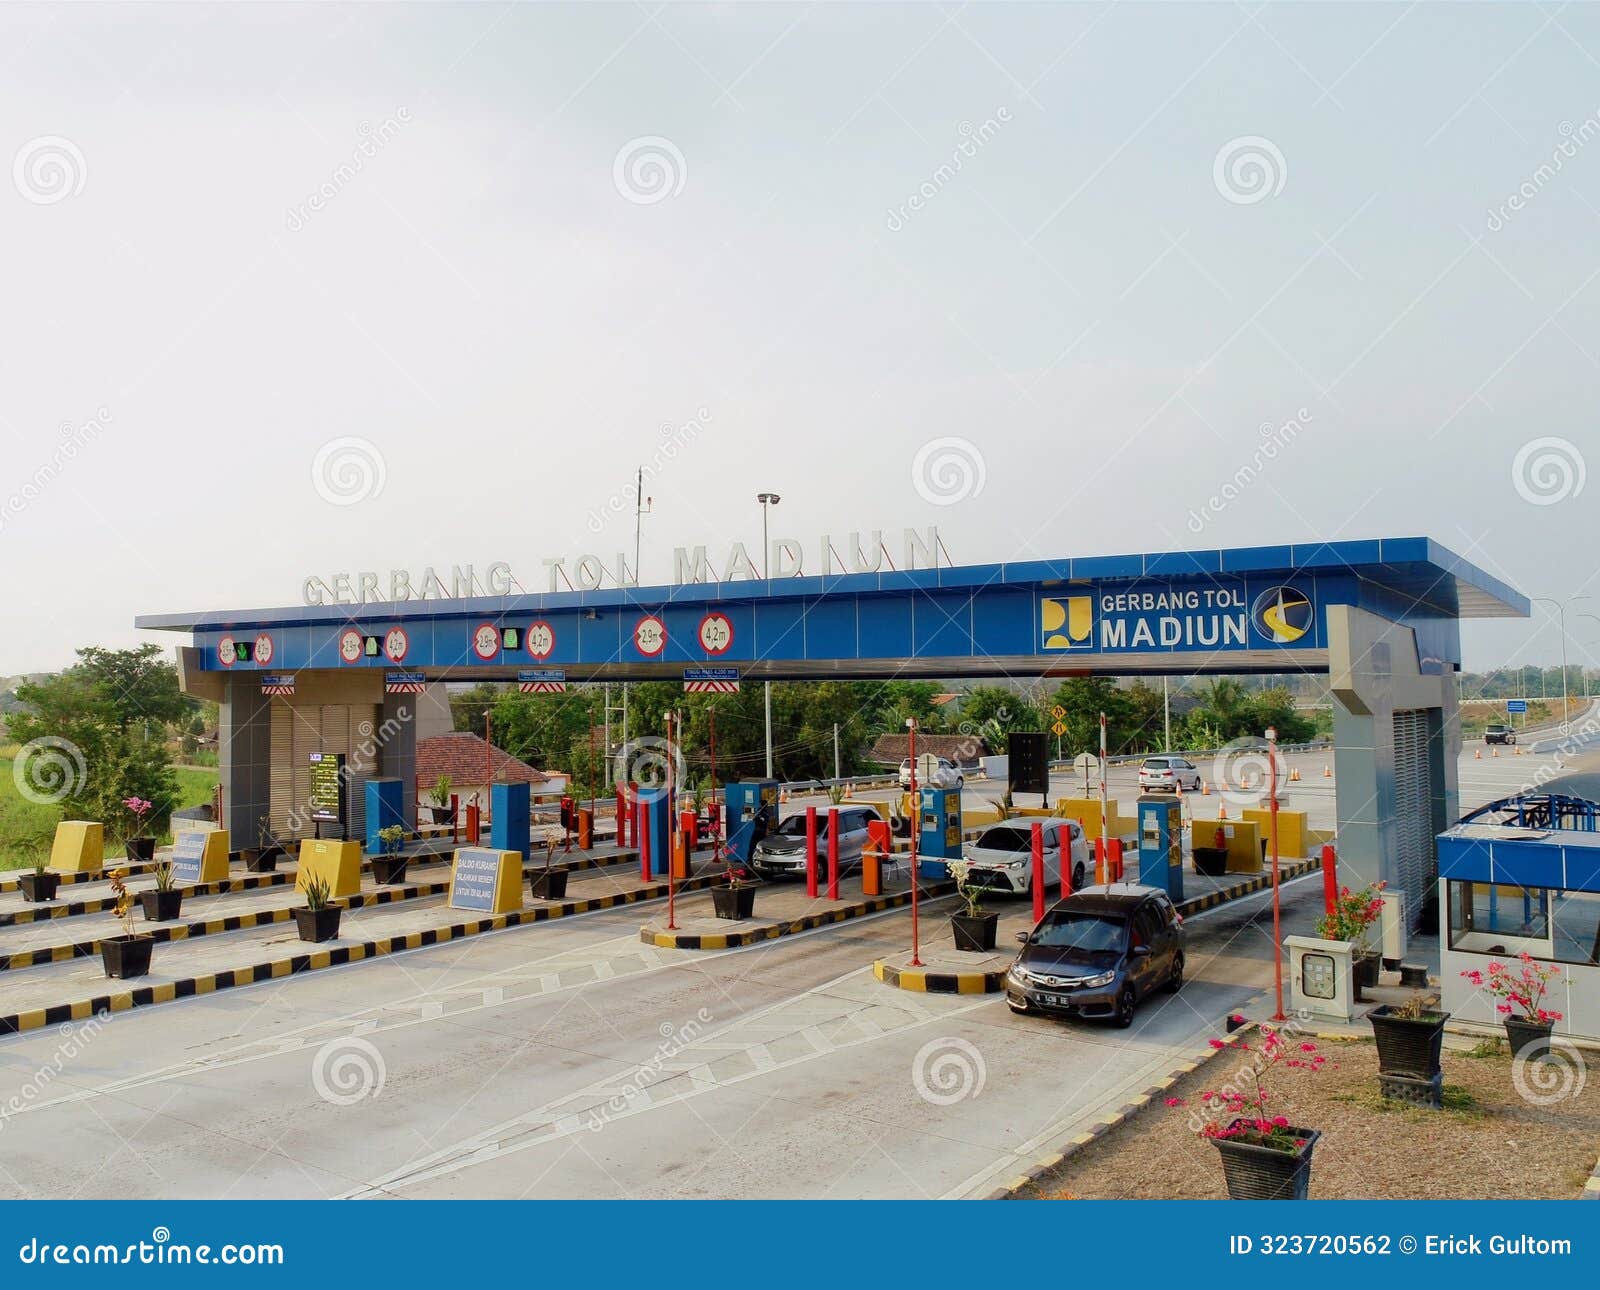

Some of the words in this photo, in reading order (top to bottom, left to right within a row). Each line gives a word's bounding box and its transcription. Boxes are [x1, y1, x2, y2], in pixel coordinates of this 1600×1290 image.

[302, 559, 512, 606] GERBANG
[542, 552, 639, 592] TOL
[673, 526, 938, 584] MADIUN
[1101, 592, 1199, 613] GERBANG
[1204, 589, 1245, 608] TOL
[705, 627, 726, 642] 4,2m
[1101, 613, 1246, 648] MADIUN
